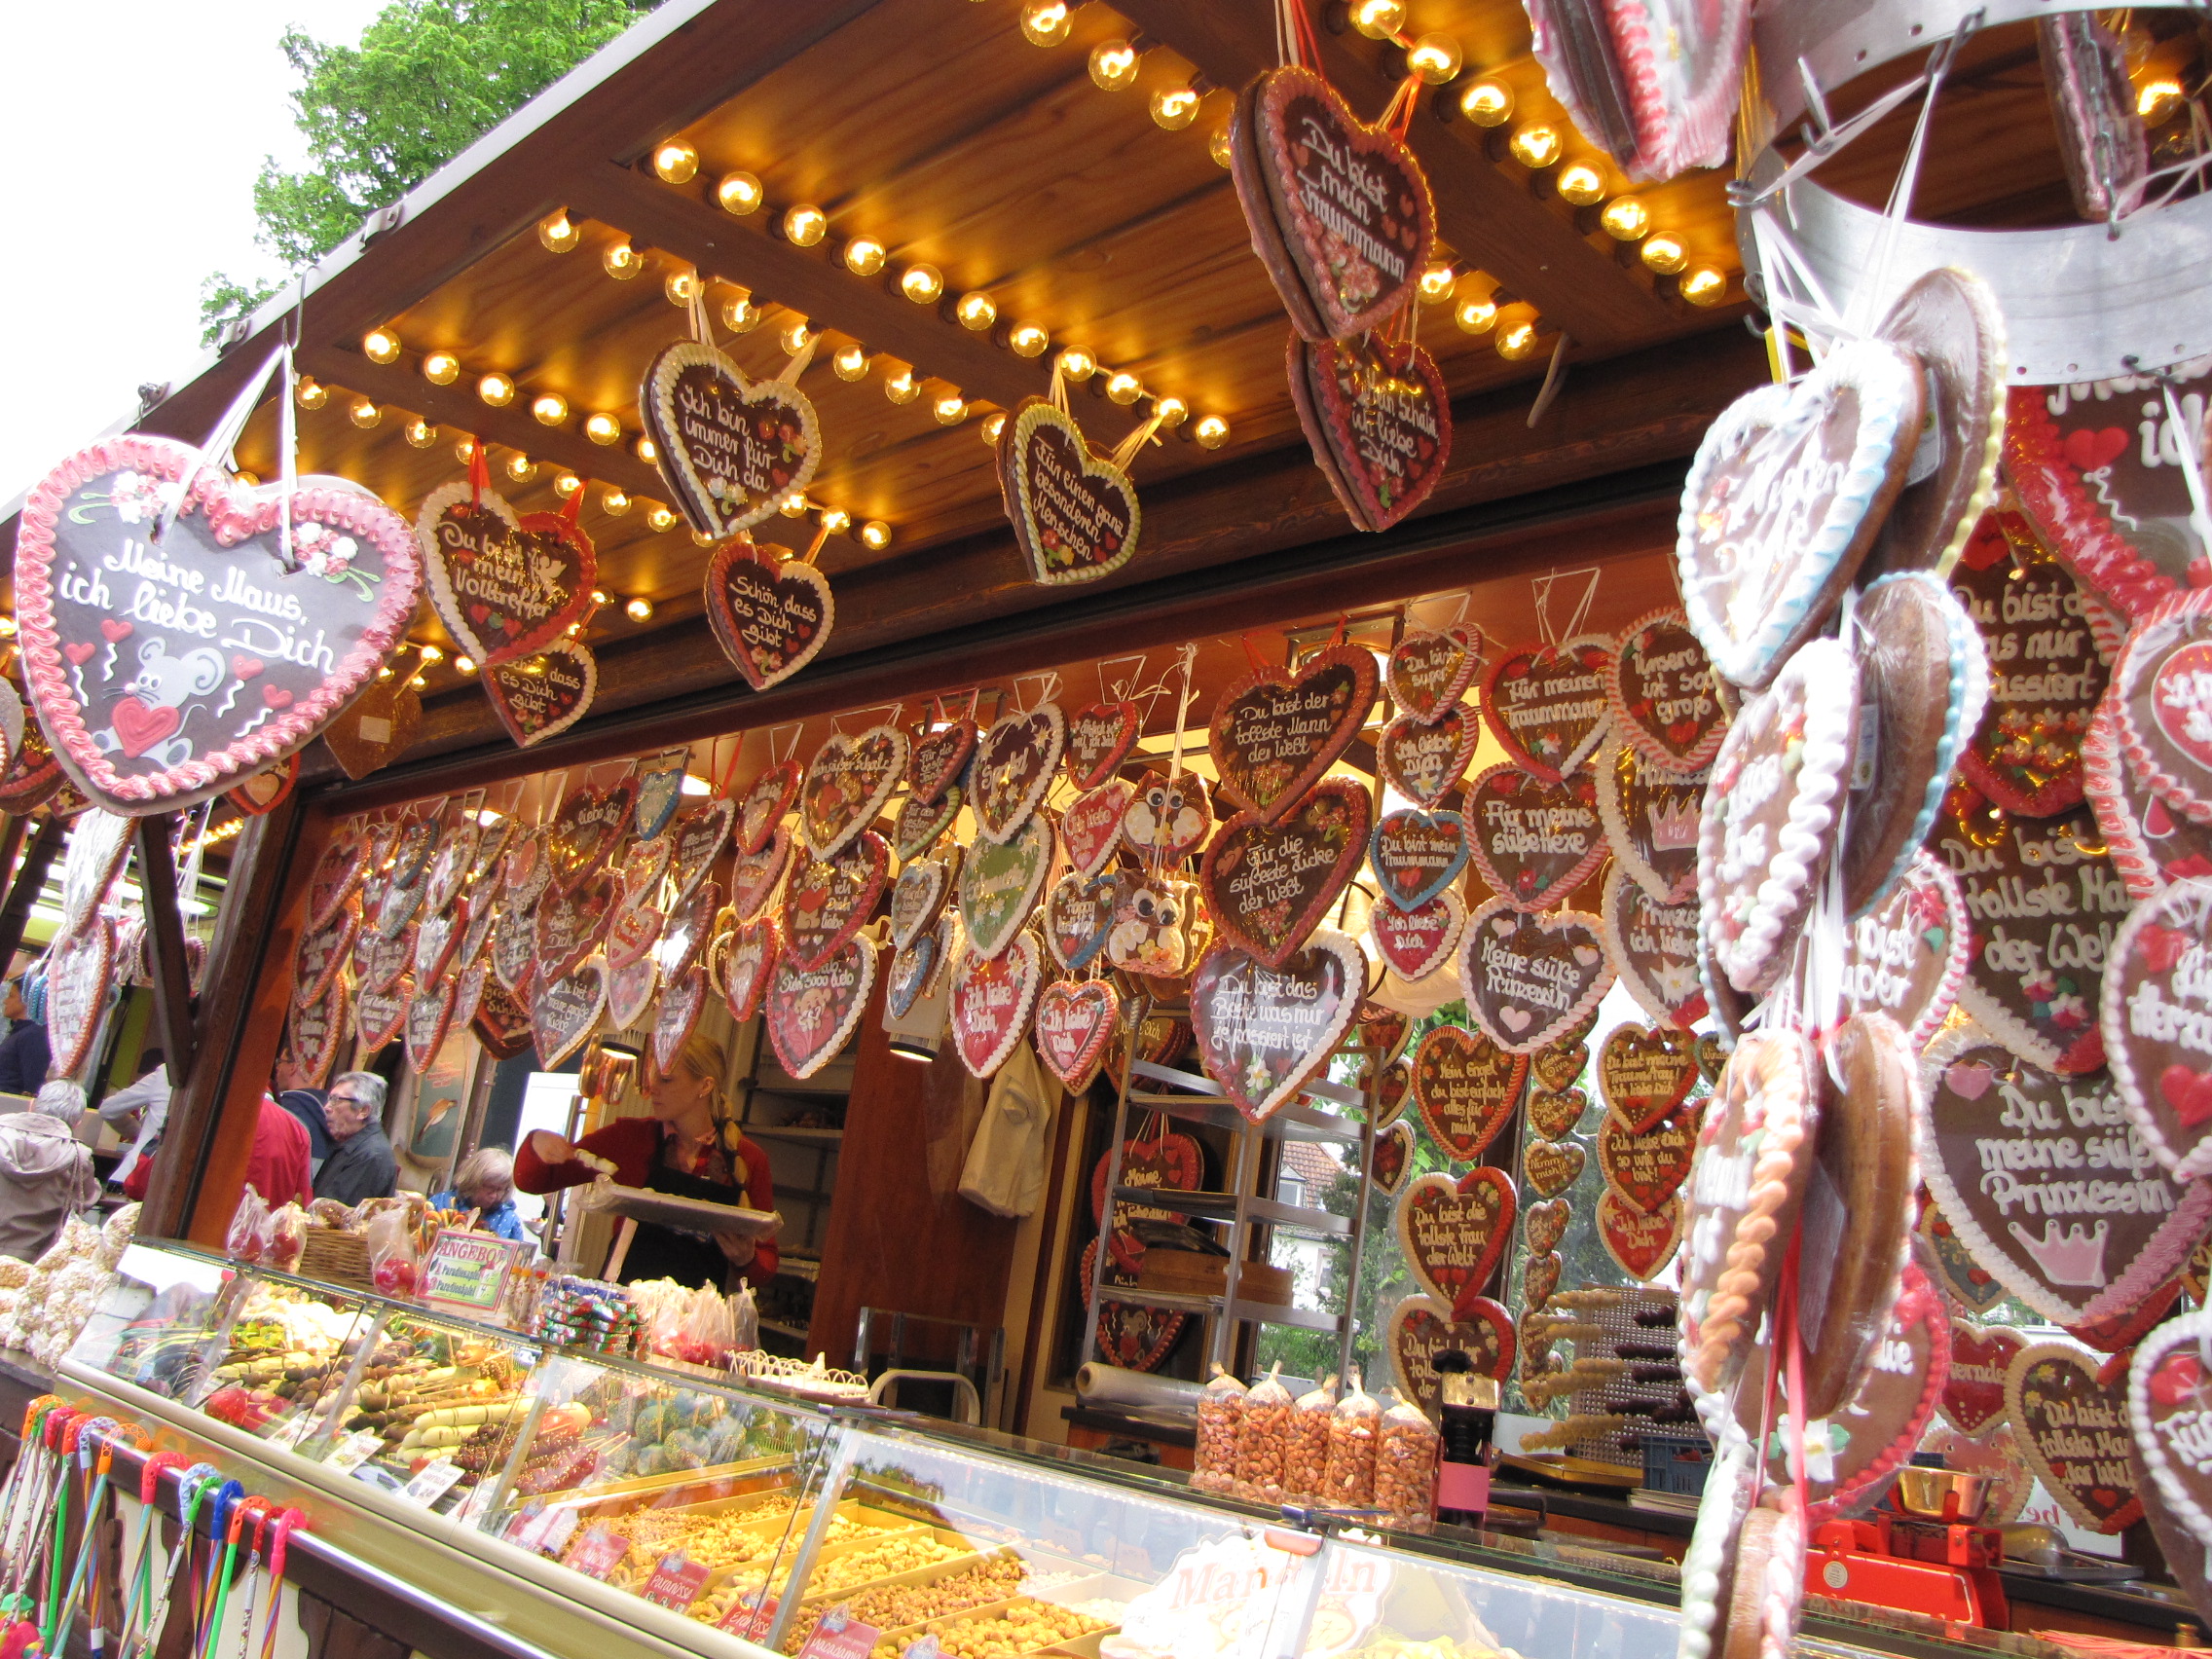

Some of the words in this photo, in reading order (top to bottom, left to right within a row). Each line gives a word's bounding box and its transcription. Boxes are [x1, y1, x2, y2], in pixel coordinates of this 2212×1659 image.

[1302, 117, 1346, 175] Du
[1346, 146, 1387, 212] bist
[1321, 166, 1371, 226] mein
[1297, 170, 1404, 283] Traummann
[682, 386, 712, 418] Ich
[718, 405, 749, 437] bin
[685, 412, 738, 453] immer
[744, 438, 777, 470] für
[1377, 418, 1417, 458] liebe
[693, 446, 739, 481] Dich
[743, 468, 771, 493] da
[1360, 436, 1404, 477] Dich
[1035, 436, 1060, 479] Für
[1063, 470, 1094, 512] einen
[1095, 502, 1124, 538] ganz
[1035, 464, 1100, 543] besonderen
[438, 522, 477, 552] Du
[1034, 491, 1092, 561] Menschen
[104, 539, 203, 595] Meine
[211, 567, 310, 625] Maus,
[474, 556, 523, 585] mein
[456, 569, 552, 620] Volltreffer
[60, 562, 113, 610] ich
[119, 590, 217, 639] liebe
[221, 618, 335, 674] Dich
[734, 602, 756, 616] es
[758, 606, 795, 634] Dich
[785, 599, 817, 623] dass
[742, 625, 783, 647] gibt
[1405, 657, 1427, 673] Du
[1428, 646, 1456, 670] bist
[1632, 647, 1698, 676] Unsere
[500, 671, 520, 688] es
[522, 678, 558, 701] Dich
[550, 667, 581, 689] dass
[1412, 668, 1449, 689] super
[1503, 678, 1539, 703] Für
[509, 693, 547, 714] gibt
[1240, 707, 1270, 721] Du
[1272, 696, 1302, 717] bist
[1305, 692, 1330, 711] der
[1656, 699, 1712, 725] groß
[1235, 719, 1282, 746] tollste
[1287, 718, 1332, 735] Mann
[921, 750, 938, 762] Für
[939, 743, 954, 757] die
[1248, 746, 1272, 763] der
[1275, 737, 1310, 756] Welt
[921, 756, 944, 773] beste
[903, 818, 930, 829] besten
[908, 804, 919, 817] Für
[920, 806, 935, 817] den
[1485, 800, 1521, 830] Für
[1525, 801, 1595, 829] meine
[1246, 844, 1276, 866] Für
[1277, 835, 1304, 858] die
[1381, 837, 1401, 856] Du
[1403, 837, 1428, 855] bist
[1430, 841, 1459, 855] mein
[1492, 828, 1540, 862] süße
[1538, 830, 1589, 856] Hexe
[1940, 838, 2004, 876] Du
[2012, 820, 2093, 866] bist
[1229, 865, 1288, 896] süßeste
[1292, 848, 1338, 874] Zicke
[834, 880, 851, 895] ich
[1238, 894, 1265, 915] der
[1266, 876, 1305, 903] Welt
[826, 898, 851, 911] Dich
[1066, 898, 1096, 923] Happy
[821, 911, 845, 930] liebe
[545, 934, 574, 950] Dich
[1481, 936, 1529, 972] Meine
[1531, 957, 1581, 988] süße
[557, 978, 571, 994] Du
[572, 981, 588, 1001] bist
[779, 976, 804, 994] Dich
[805, 976, 830, 987] sooo
[963, 986, 986, 1011] Ich
[987, 980, 1014, 1007] liebe
[1218, 974, 1250, 996] Du
[1255, 974, 1284, 999] bist
[1285, 975, 1317, 1000] das
[1487, 966, 1571, 1011] Prinzessin
[565, 1005, 590, 1023] große
[967, 1009, 999, 1033] Dich
[1211, 997, 1258, 1022] Beste
[1260, 1005, 1292, 1023] was
[1293, 999, 1325, 1024] mir
[1211, 1024, 1233, 1050] je
[1234, 1025, 1290, 1052] passiert
[1440, 1062, 1464, 1079] Mein
[1466, 1058, 1497, 1084] Engel
[1546, 1060, 1569, 1077] Diva
[1606, 1052, 1622, 1070] Du
[1623, 1051, 1645, 1068] bist
[1645, 1051, 1689, 1067] meine
[1430, 1084, 1448, 1099] du
[1449, 1081, 1469, 1098] bist
[1469, 1079, 1506, 1105] einfach
[1610, 1085, 1628, 1099] Ich
[1629, 1083, 1653, 1097] liebe
[1653, 1081, 1675, 1096] Dich
[1443, 1098, 1466, 1116] alles
[1467, 1098, 1485, 1126] für
[1999, 1085, 2062, 1129] Du
[2060, 1085, 2128, 1128] bis
[1610, 1133, 1631, 1152] Ich
[1634, 1132, 1660, 1150] liebe
[1661, 1130, 1687, 1149] Dich
[1975, 1127, 2085, 1170] meine
[2084, 1124, 2156, 1169] süß
[1530, 1156, 1561, 1170] Nimm
[1617, 1154, 1632, 1168] so
[1634, 1152, 1655, 1166] wie
[1657, 1150, 1677, 1166] du
[1124, 1166, 1162, 1188] Meine
[1980, 1168, 2176, 1216] Prinzessin
[1415, 1207, 1436, 1227] Du
[1439, 1203, 1465, 1224] bist
[1466, 1201, 1488, 1221] die
[1616, 1214, 1636, 1233] Ich
[1418, 1225, 1457, 1246] tollste
[1458, 1224, 1488, 1245] Frau
[1626, 1231, 1657, 1250] Dich
[437, 1240, 507, 1265] ANGEBOT
[1426, 1249, 1448, 1266] der
[1448, 1246, 1477, 1267] Welt
[435, 1262, 442, 1275] 1
[1419, 1381, 1437, 1399] der
